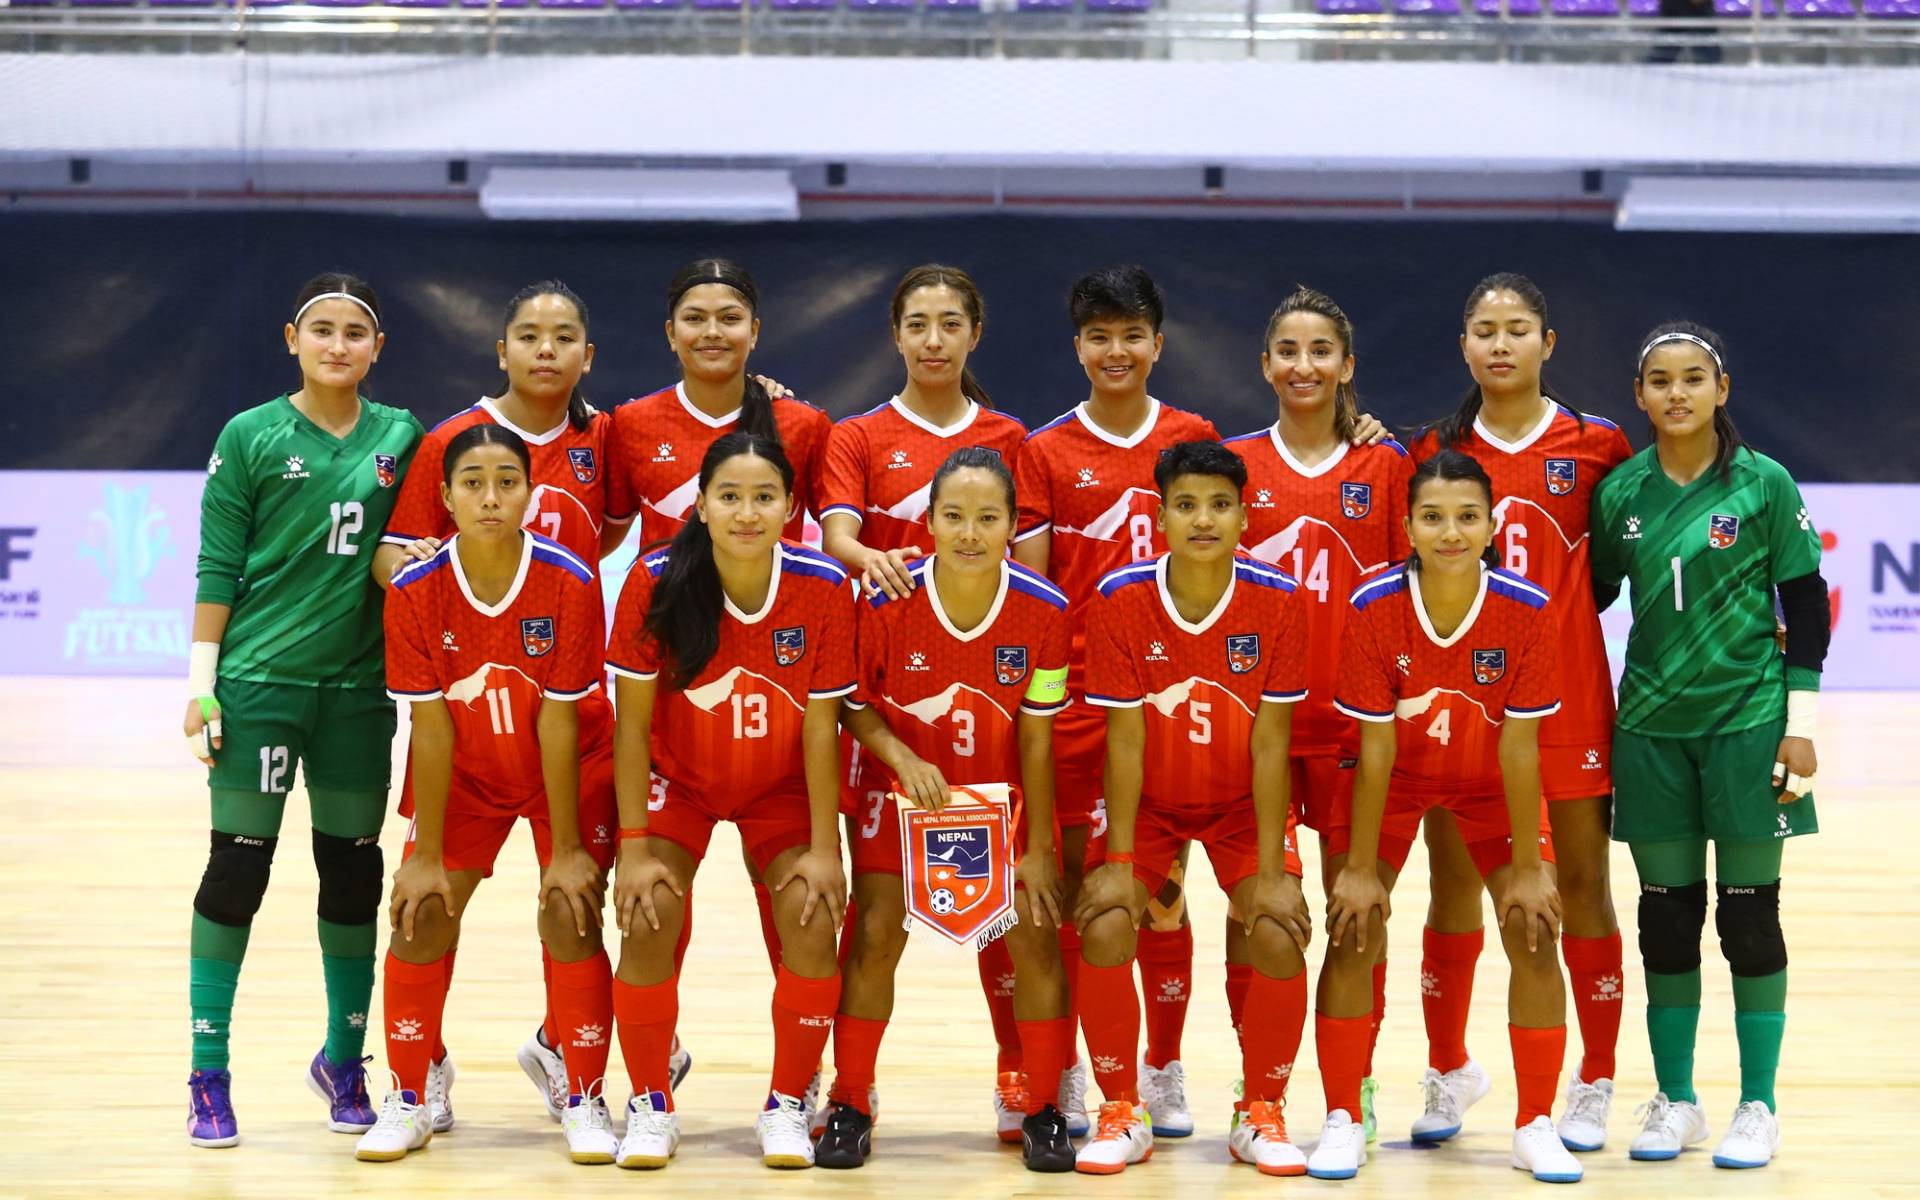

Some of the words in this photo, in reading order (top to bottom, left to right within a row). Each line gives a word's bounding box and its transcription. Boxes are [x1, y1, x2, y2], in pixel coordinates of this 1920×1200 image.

[283, 472, 310, 480] KELME
[1075, 480, 1100, 489] KELME
[327, 501, 364, 555] 12
[541, 512, 562, 541] 7
[1129, 514, 1153, 563] 8
[1623, 532, 1643, 540] KELME
[1505, 523, 1528, 577] 6
[1292, 548, 1330, 603] 14
[1671, 556, 1684, 611] 1
[486, 687, 515, 735] 11
[731, 693, 768, 739] 13
[952, 709, 976, 758] 3
[1188, 700, 1212, 745] 5
[1425, 708, 1451, 746] 4
[259, 746, 289, 793] 12
[863, 790, 885, 839] 3
[940, 815, 965, 823] FOOTBALL
[966, 813, 999, 822] ASSOCIATION
[937, 832, 976, 843] NEPAL
[390, 1033, 425, 1042] KELME
[800, 1017, 835, 1027] KELM
